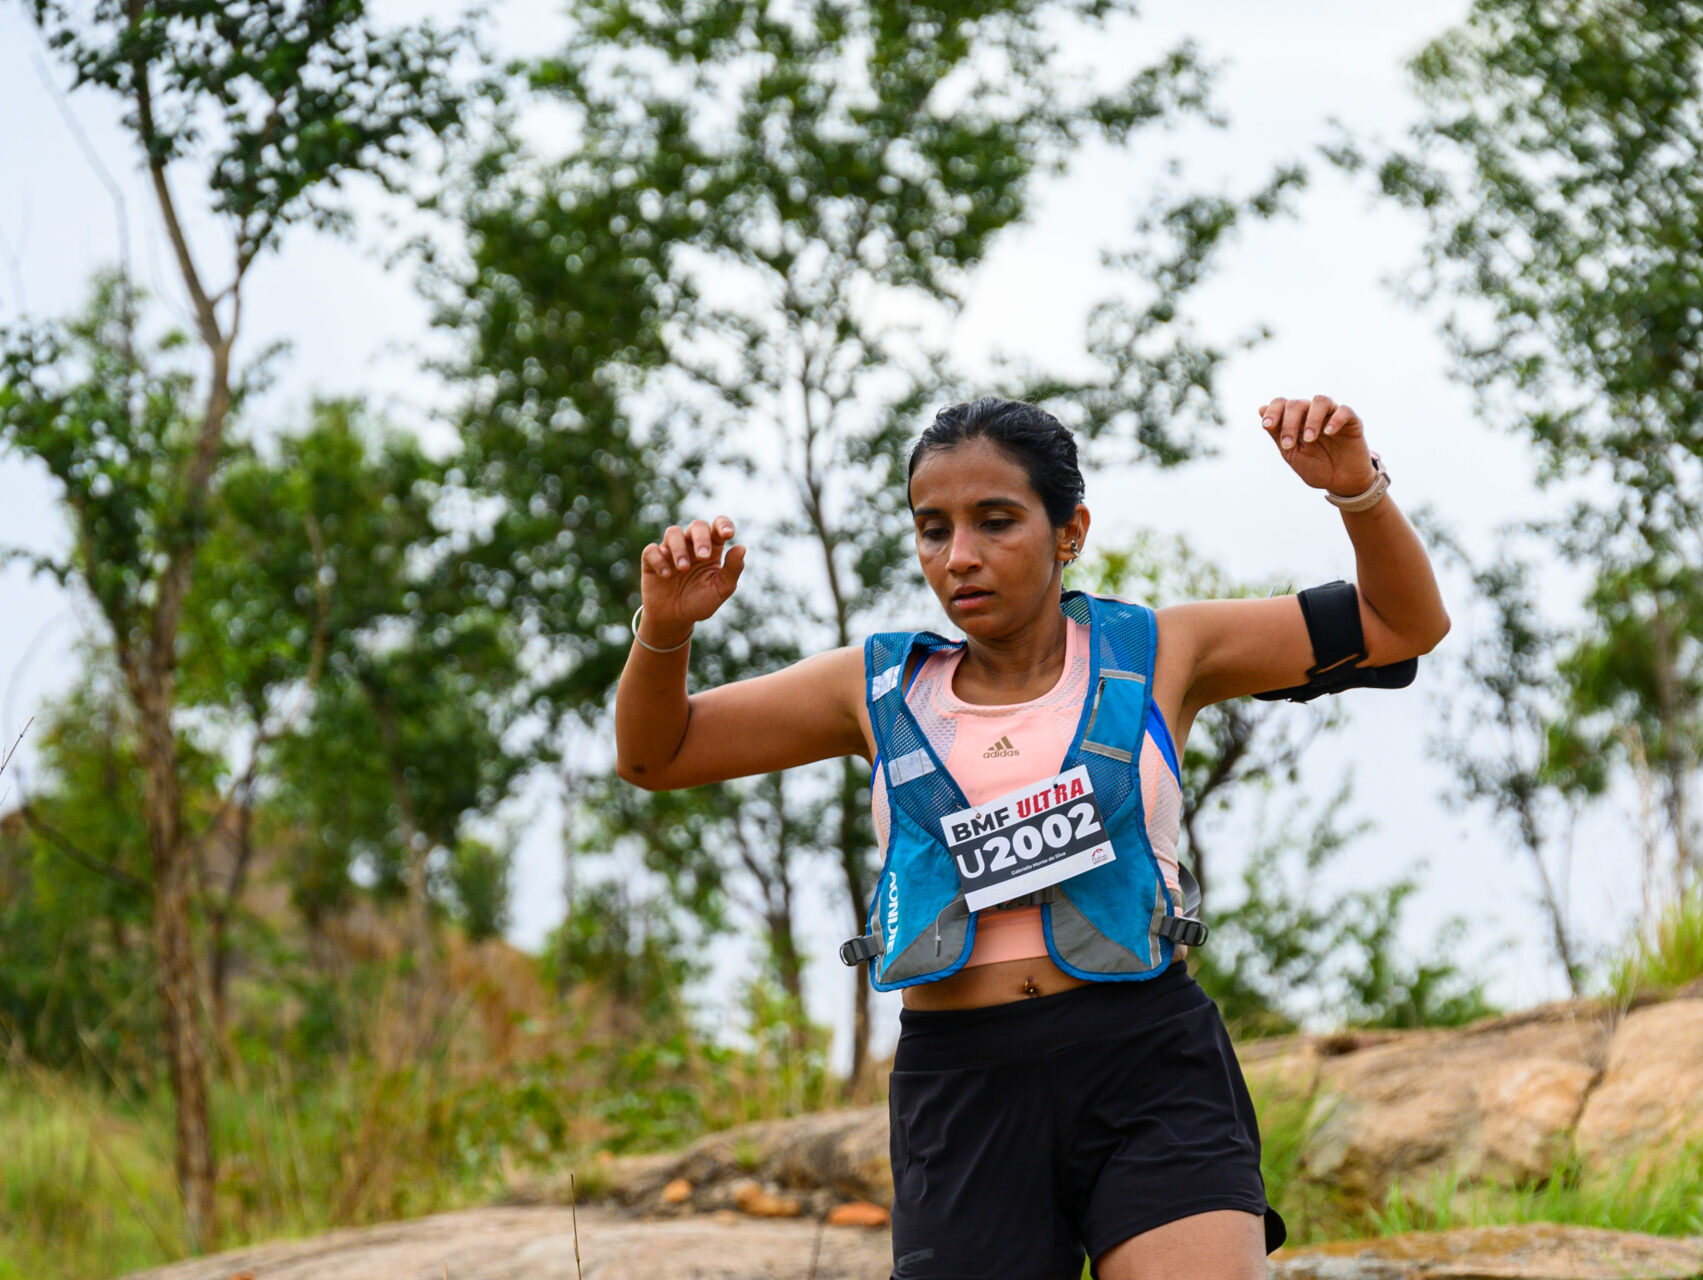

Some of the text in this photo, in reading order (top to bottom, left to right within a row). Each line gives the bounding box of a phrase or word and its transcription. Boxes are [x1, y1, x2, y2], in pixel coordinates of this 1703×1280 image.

[983, 750, 1020, 758] adidas
[951, 778, 1084, 842] BMF ULTRA
[956, 802, 1101, 878] U2002
